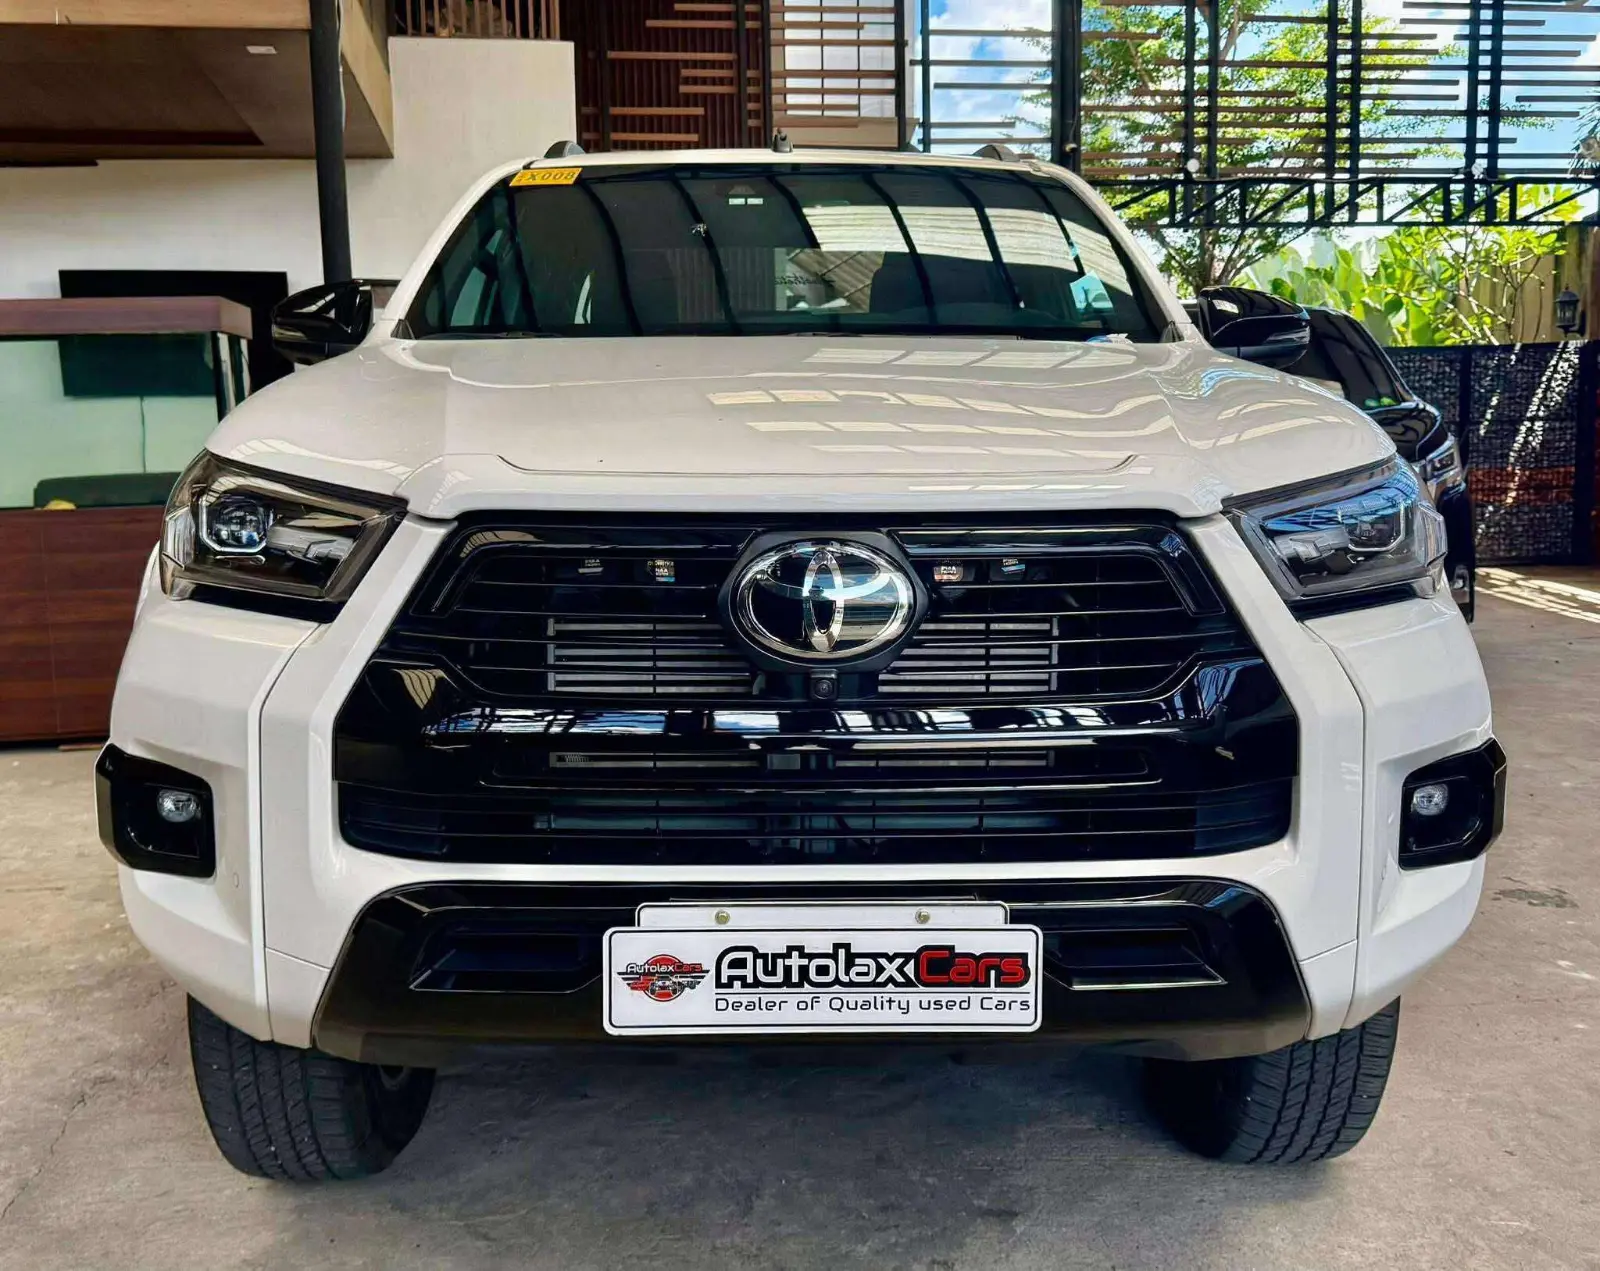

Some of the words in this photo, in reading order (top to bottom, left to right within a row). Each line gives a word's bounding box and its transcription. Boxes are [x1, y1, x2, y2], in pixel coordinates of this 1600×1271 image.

[715, 996, 789, 1012] Dealer
[796, 995, 821, 1012] of
[828, 995, 910, 1015] Quality
[918, 995, 971, 1012] used
[980, 996, 1030, 1012] Cars
